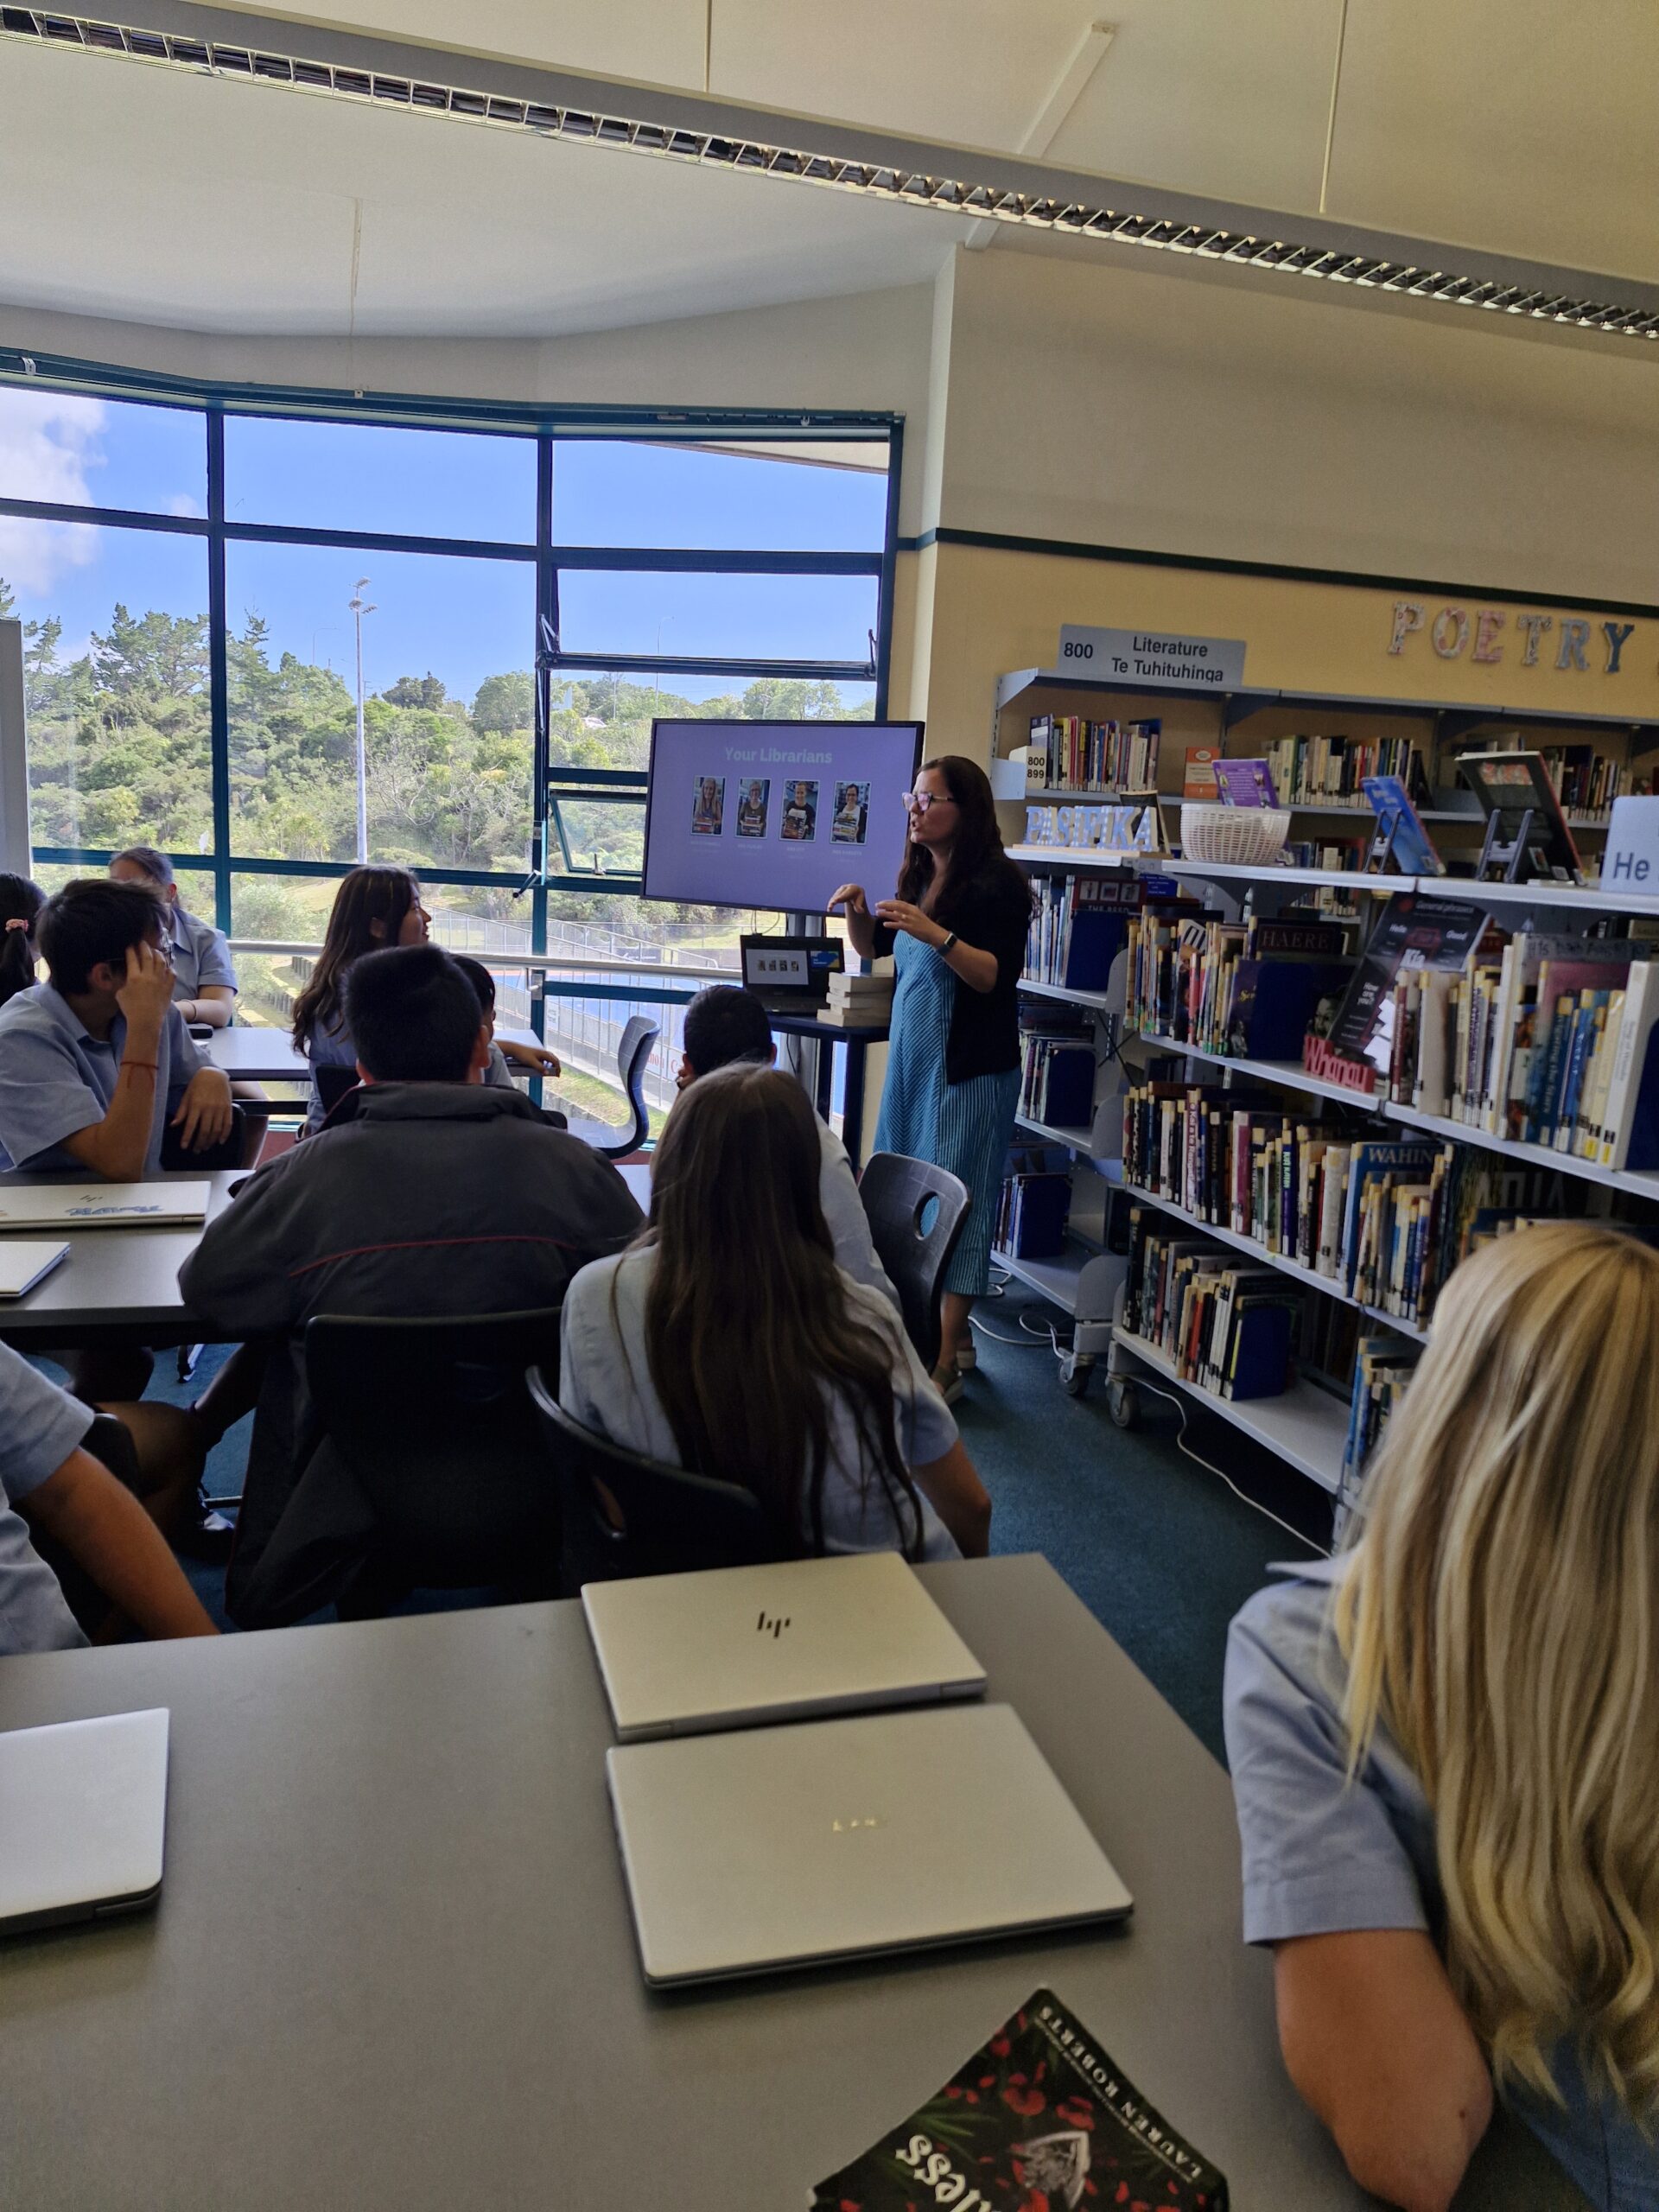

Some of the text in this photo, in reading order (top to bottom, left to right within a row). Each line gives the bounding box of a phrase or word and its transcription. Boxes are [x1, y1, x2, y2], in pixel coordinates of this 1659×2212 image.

[1132, 636, 1209, 658] Literature
[1387, 601, 1636, 674] POETRY
[1064, 642, 1094, 659] 800
[1112, 658, 1129, 674] Te
[725, 747, 833, 765] Your Librarians
[1027, 756, 1045, 766] 800
[1027, 768, 1045, 779] 899
[1022, 805, 1157, 851] PASIFIKA
[1612, 852, 1649, 880] He
[1262, 930, 1331, 950] HAERE
[1399, 949, 1426, 969] Kia
[1363, 982, 1380, 992] How
[1039, 2005, 1205, 2178] LAUREN ROBERTS
